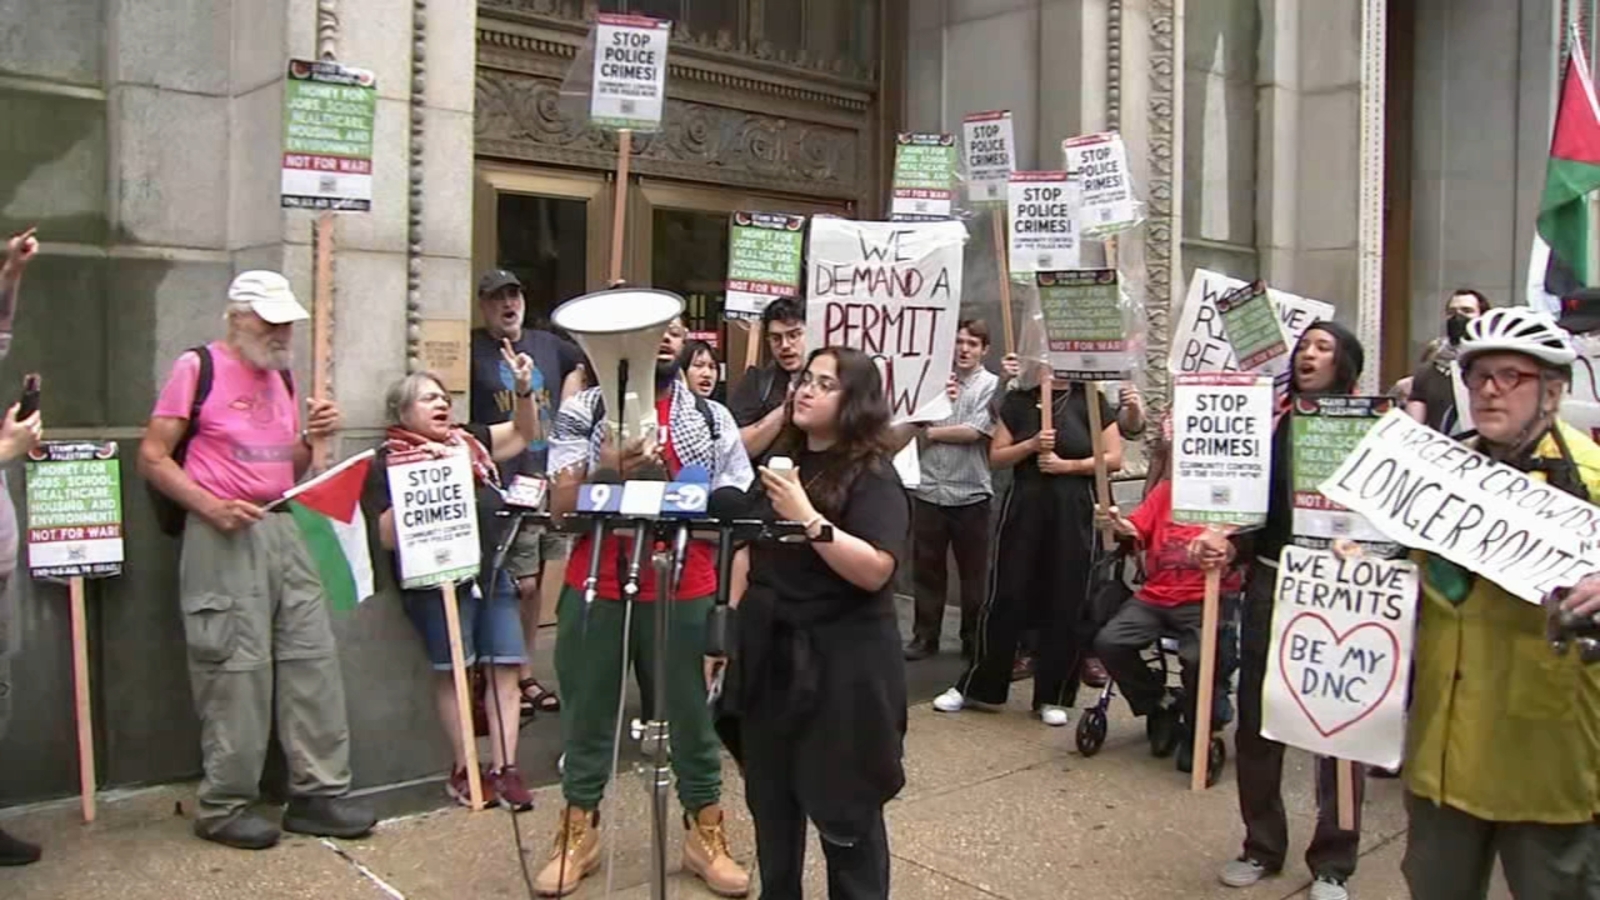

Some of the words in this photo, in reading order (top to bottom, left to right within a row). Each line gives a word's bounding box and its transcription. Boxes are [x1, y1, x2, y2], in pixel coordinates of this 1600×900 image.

[612, 31, 651, 47] STOP
[604, 48, 656, 65] POLICE
[600, 63, 658, 81] CRIMES!
[342, 88, 367, 101] FOR
[973, 124, 1001, 139] STOP
[970, 138, 1006, 152] POLICE
[285, 154, 310, 168] NOT
[314, 156, 337, 169] FOR
[339, 158, 370, 172] WAR!
[969, 153, 1010, 167] CRIMES!
[1080, 147, 1111, 163] STOP
[1084, 174, 1123, 192] RIMES!
[895, 189, 911, 197] NOT
[1023, 187, 1063, 202] STOP
[1017, 203, 1068, 218] POLICE
[1014, 219, 1072, 234] CRIMES!
[858, 229, 916, 262] WE
[729, 281, 747, 290] NOT
[750, 283, 768, 292] FOR
[771, 285, 795, 296] WAR!
[815, 264, 924, 298] DEMAND
[930, 266, 950, 298] A
[824, 302, 946, 357] PERMIT
[1050, 340, 1070, 350] NOT
[1074, 340, 1095, 350] FOR
[1195, 394, 1248, 412] STOP
[1186, 415, 1257, 435] POLICE
[1306, 420, 1351, 433] MONEY
[1354, 420, 1374, 431] FO
[1181, 438, 1260, 458] CRIMES!
[38, 464, 78, 476] MONEY
[83, 463, 106, 474] FOR
[1179, 462, 1224, 470] COMMUNITY
[1227, 463, 1263, 471] CONTROL
[408, 466, 453, 487] STOP
[1377, 417, 1482, 479] LARGER
[1479, 469, 1600, 538] CROWDS
[91, 499, 116, 510] AND
[404, 484, 463, 508] POLICE
[590, 483, 611, 512] 9
[1296, 494, 1321, 507] NOT
[1337, 447, 1485, 550] LONGER
[403, 502, 468, 528] CRIMES!
[31, 529, 56, 541] NOT
[60, 527, 84, 540] FOR
[88, 525, 120, 538] WAR!
[1286, 551, 1329, 580] WE
[1336, 559, 1411, 591] LOVE
[1279, 576, 1404, 621] PERMITS
[1289, 634, 1328, 665] BE
[1339, 647, 1386, 674] MY
